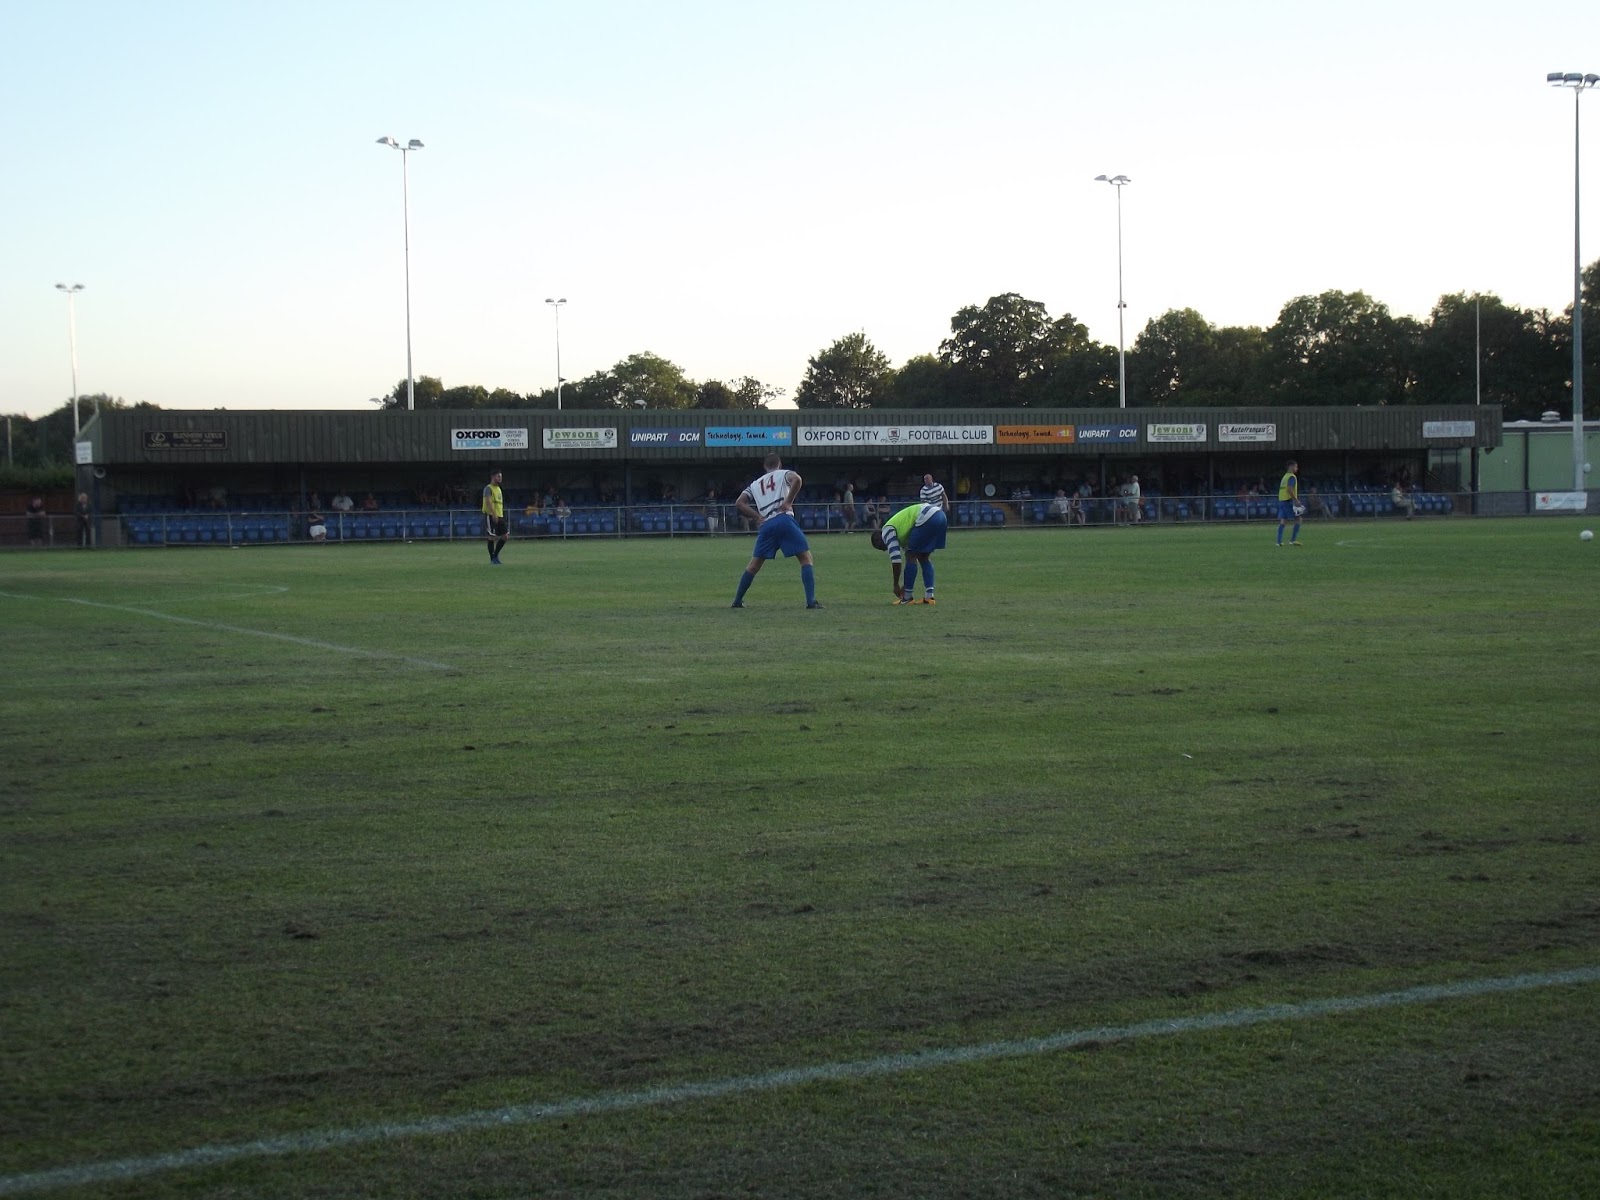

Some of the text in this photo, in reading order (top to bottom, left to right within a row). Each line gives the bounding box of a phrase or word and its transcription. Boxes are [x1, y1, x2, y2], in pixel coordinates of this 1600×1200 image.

[999, 429, 1031, 439] Technology.
[1033, 429, 1053, 437] Tamed.
[1079, 429, 1111, 438] UNIPART
[1119, 428, 1138, 438] DCM
[1151, 424, 1194, 435] Jewsons
[456, 430, 501, 440] OXFORD
[548, 429, 600, 441] Jewsons
[631, 432, 700, 442] UNIPART DCM
[707, 431, 744, 442] Technology.
[746, 431, 768, 439] Tamed.
[804, 429, 988, 441] OXFORD CITY FOOTBALL CLUB
[456, 440, 501, 448] mazda
[759, 474, 776, 496] 14
